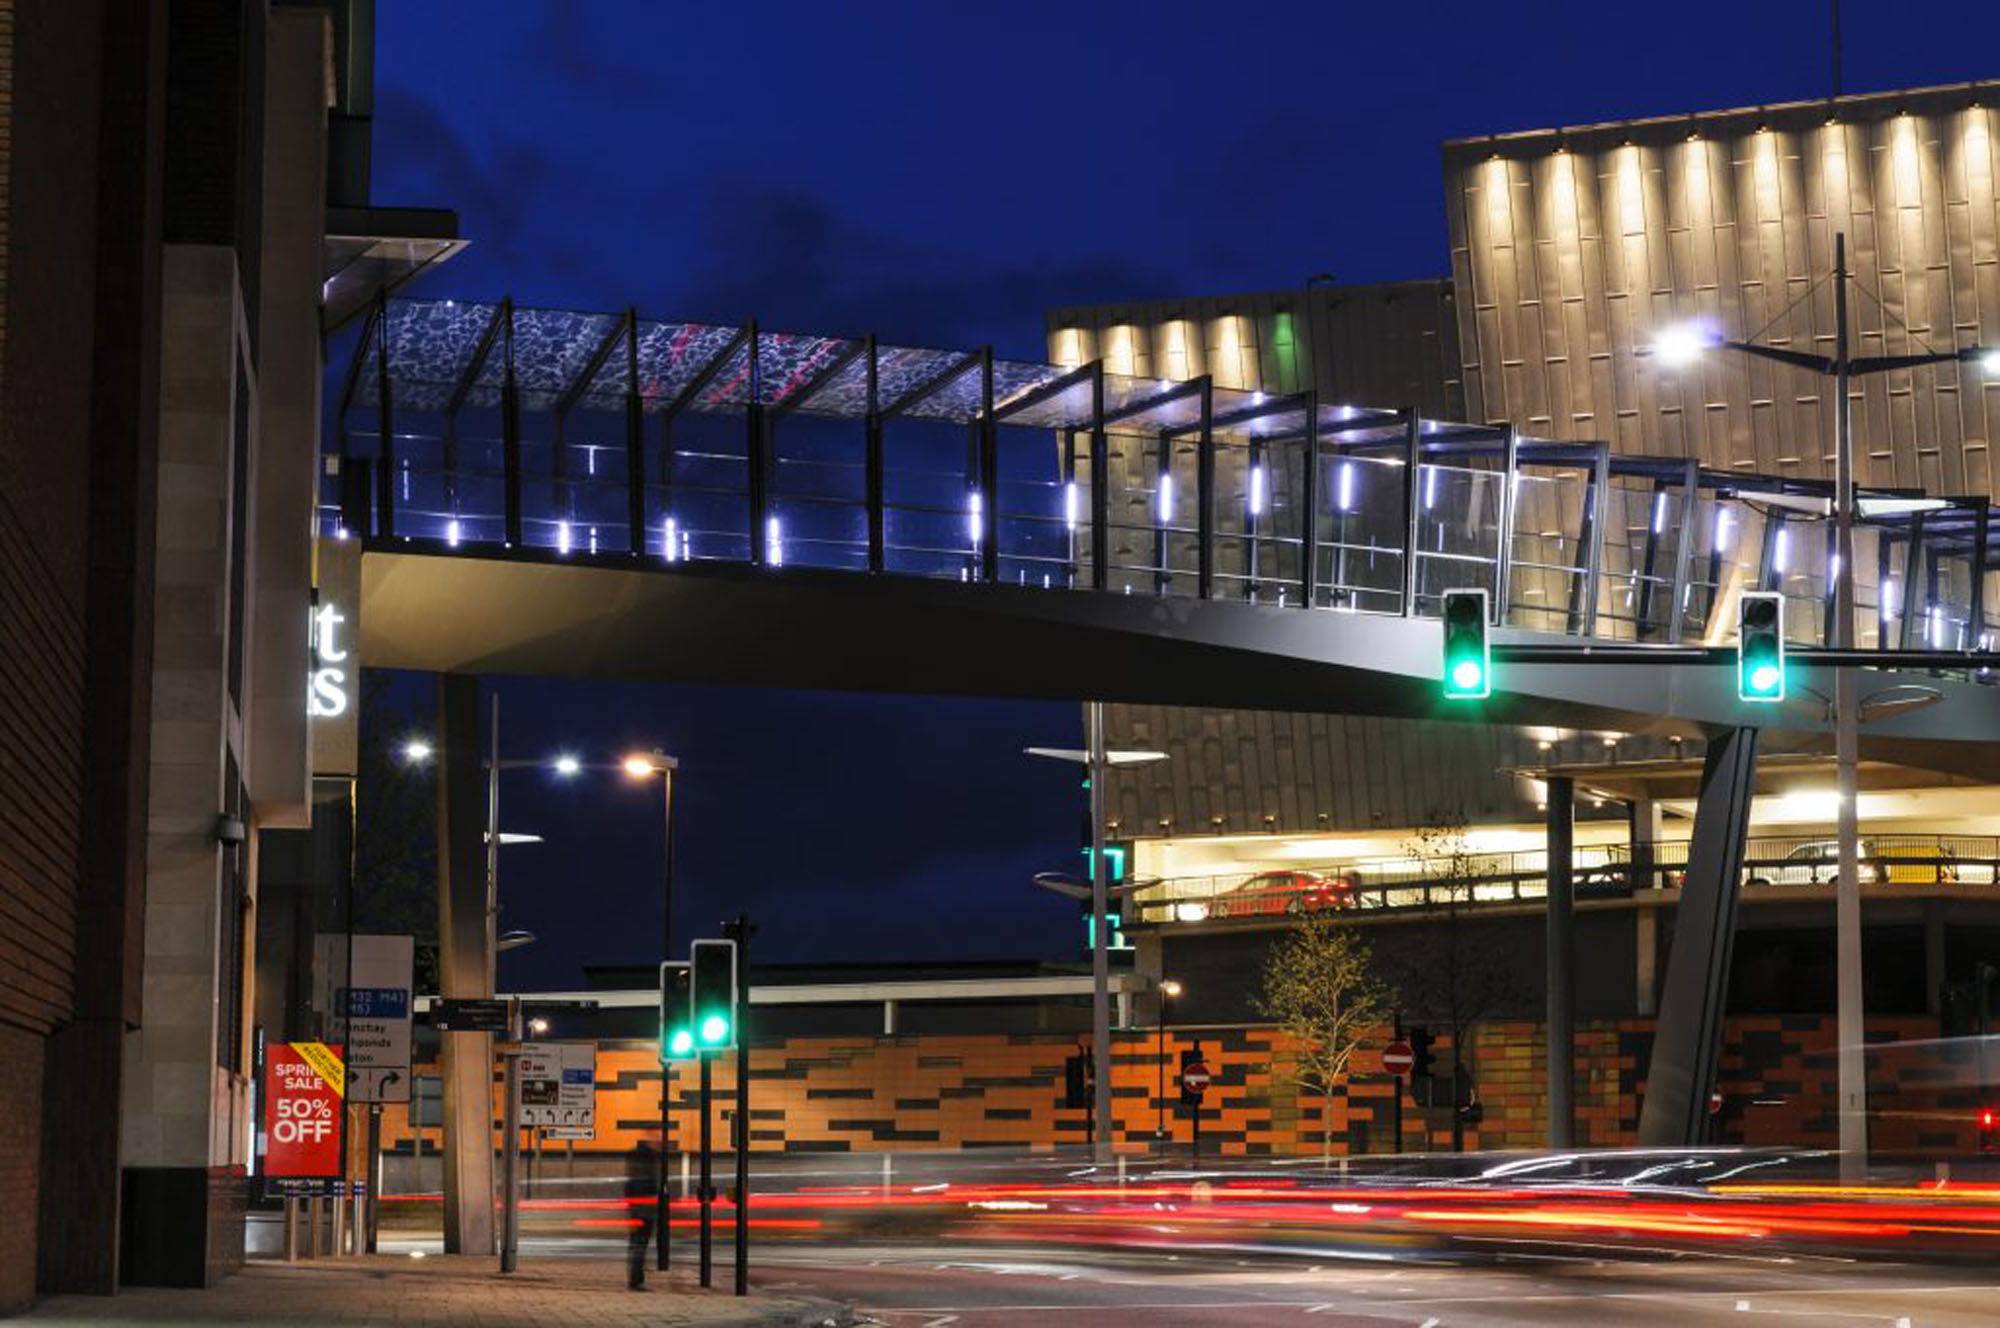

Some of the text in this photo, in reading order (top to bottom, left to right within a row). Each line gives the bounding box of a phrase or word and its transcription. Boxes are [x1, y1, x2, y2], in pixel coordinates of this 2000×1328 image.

[308, 603, 347, 661] t
[307, 668, 347, 716] s
[275, 1063, 314, 1077] SPRI
[284, 1077, 324, 1090] SALE
[277, 1098, 332, 1119] 50%
[273, 1120, 332, 1143] OFF
